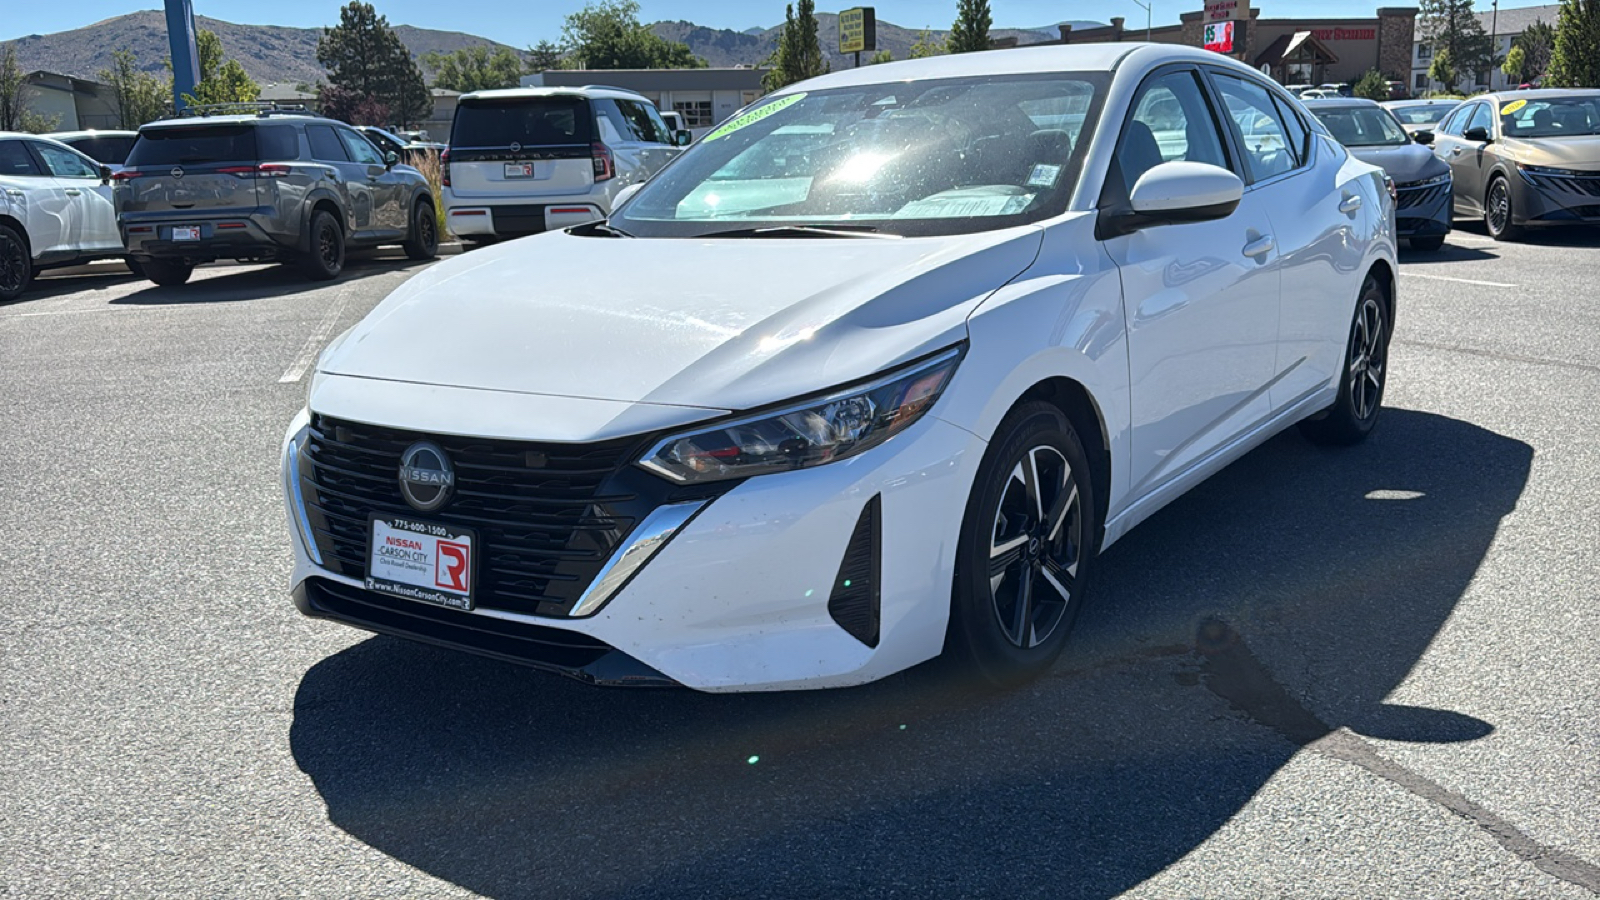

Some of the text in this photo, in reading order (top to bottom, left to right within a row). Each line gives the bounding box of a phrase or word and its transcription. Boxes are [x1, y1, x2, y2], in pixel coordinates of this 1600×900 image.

[400, 468, 451, 484] NISSAN
[394, 519, 447, 536] 775-600-1500
[385, 536, 422, 550] NISSAN
[380, 545, 428, 562] CARSON CITY
[374, 583, 462, 606] www.NissanCarsonCity.com
